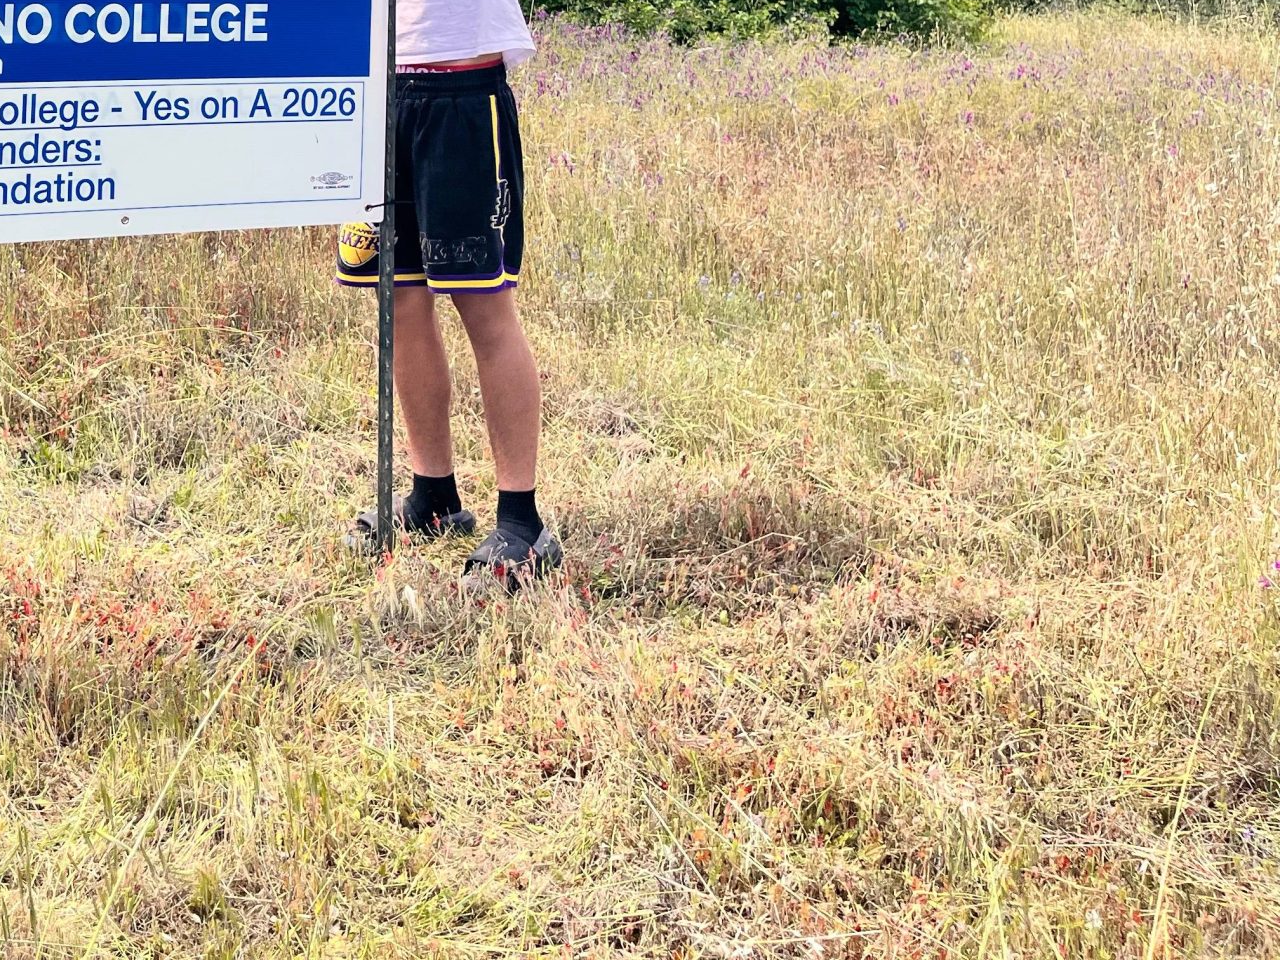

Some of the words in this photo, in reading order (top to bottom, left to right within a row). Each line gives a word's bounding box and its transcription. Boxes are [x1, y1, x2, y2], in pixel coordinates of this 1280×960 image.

[65, 4, 268, 43] COLLEGE
[135, 91, 189, 120] Yes
[201, 97, 238, 119] on
[249, 89, 271, 117] A
[283, 88, 355, 116] 2026
